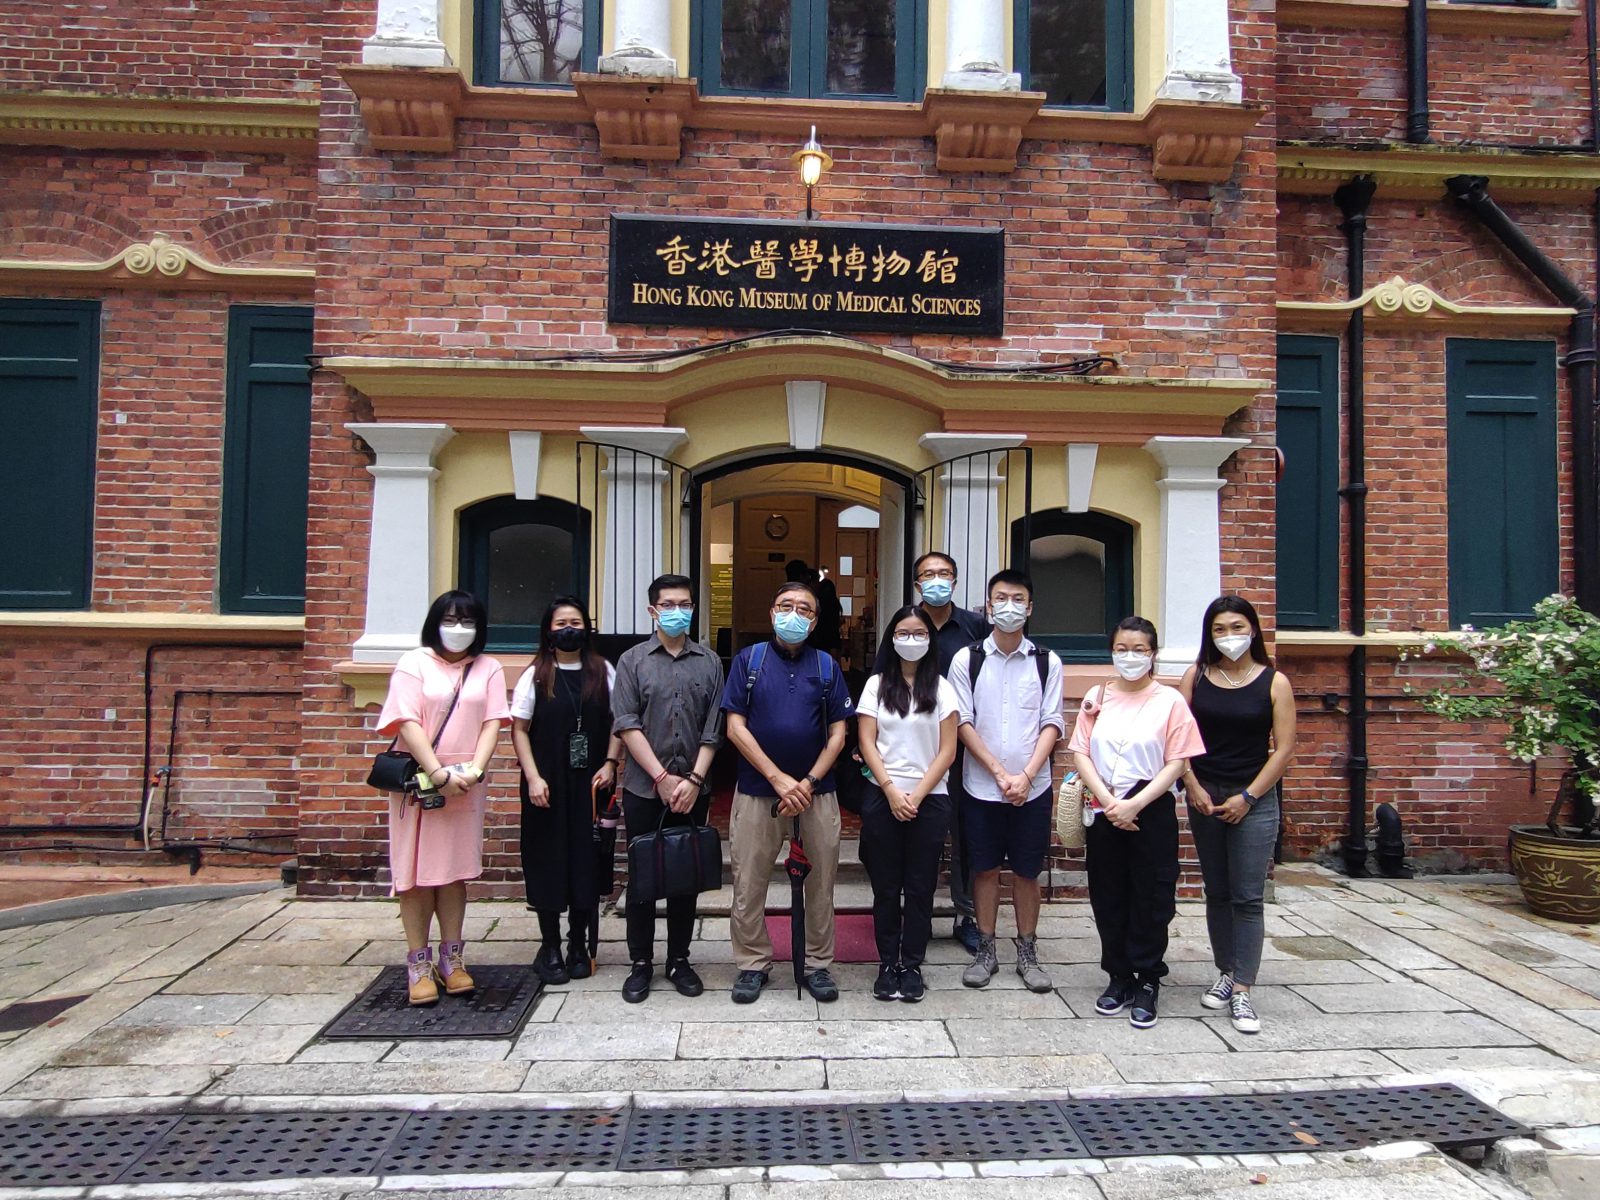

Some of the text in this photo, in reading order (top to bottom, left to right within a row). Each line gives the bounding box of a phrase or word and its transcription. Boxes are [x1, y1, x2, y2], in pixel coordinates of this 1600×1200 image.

[656, 235, 959, 284] 香港醫學博物館
[632, 282, 981, 316] HONG KONG MUSEUM OF MEDICAL SCIENCES
